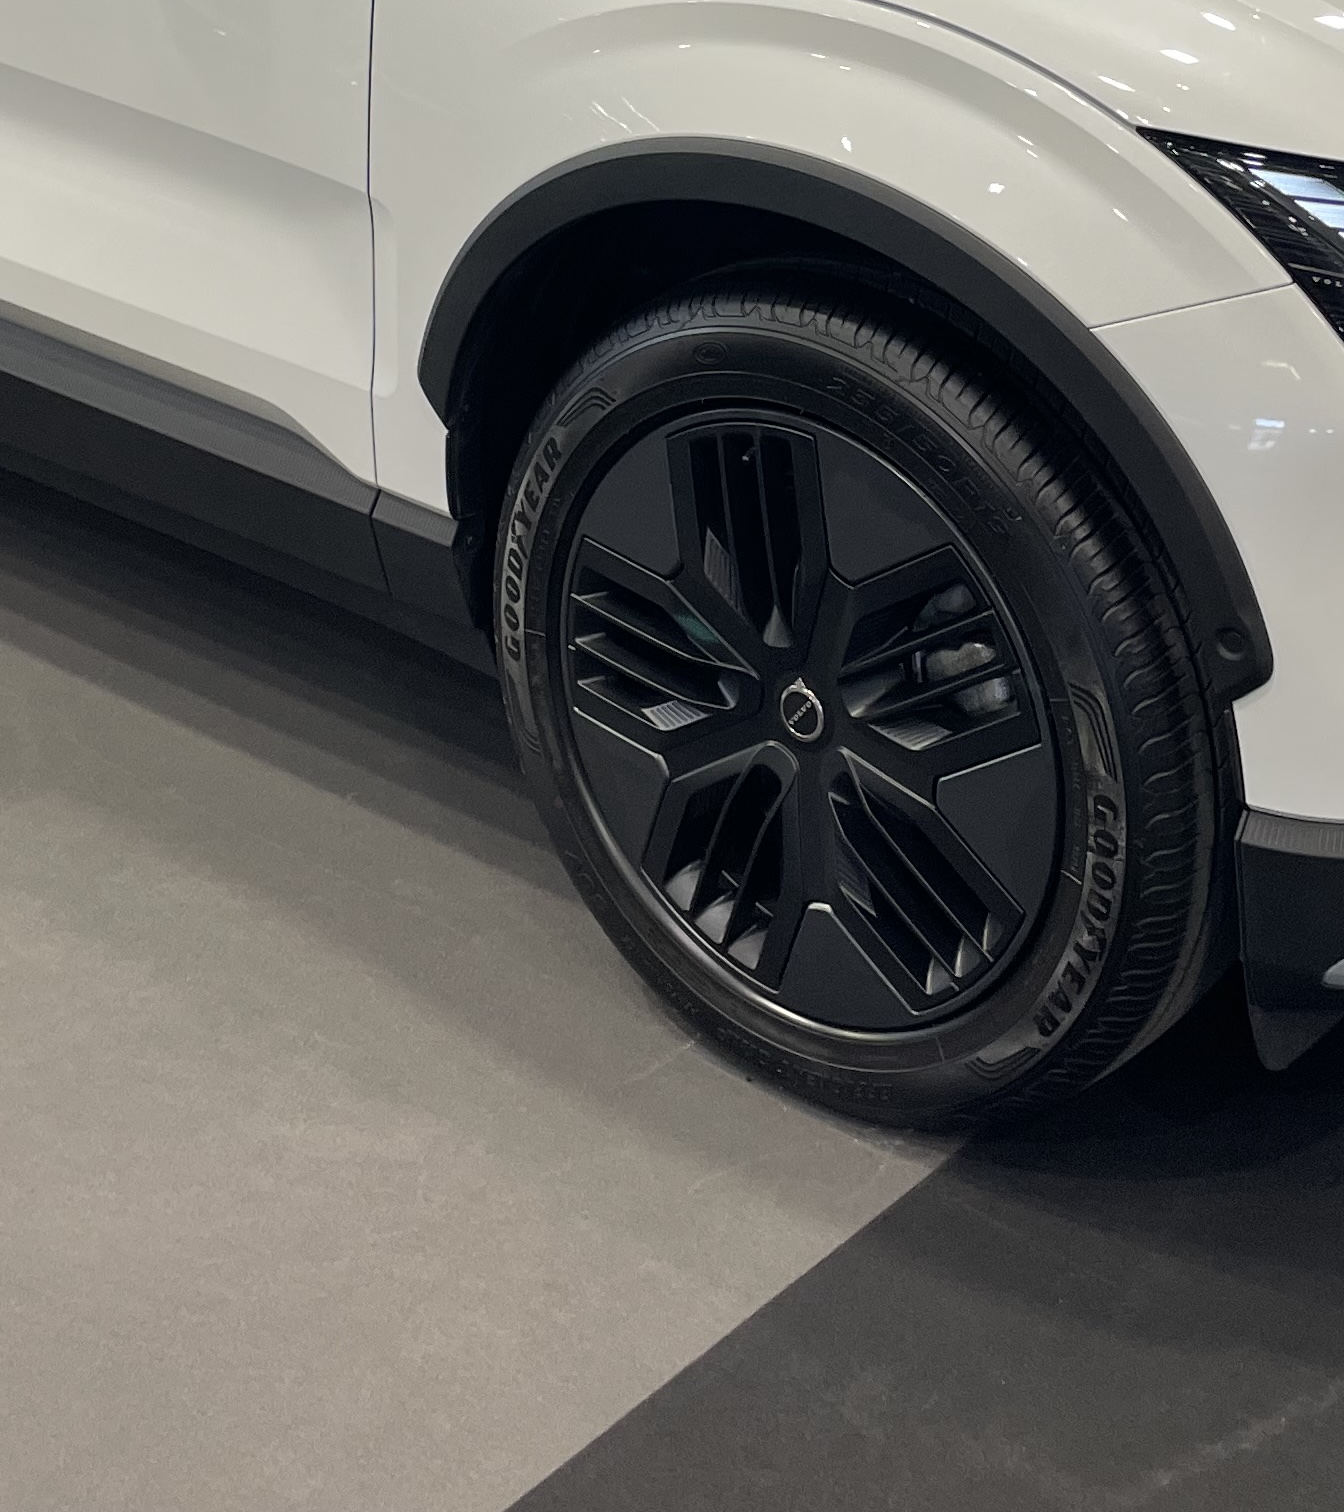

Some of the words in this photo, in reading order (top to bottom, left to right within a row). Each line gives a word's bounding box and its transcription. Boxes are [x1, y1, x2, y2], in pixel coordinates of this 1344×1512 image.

[502, 435, 564, 663] GOODYEAR
[787, 700, 813, 726] VOLVO
[1032, 793, 1119, 1039] GOODYEAR
